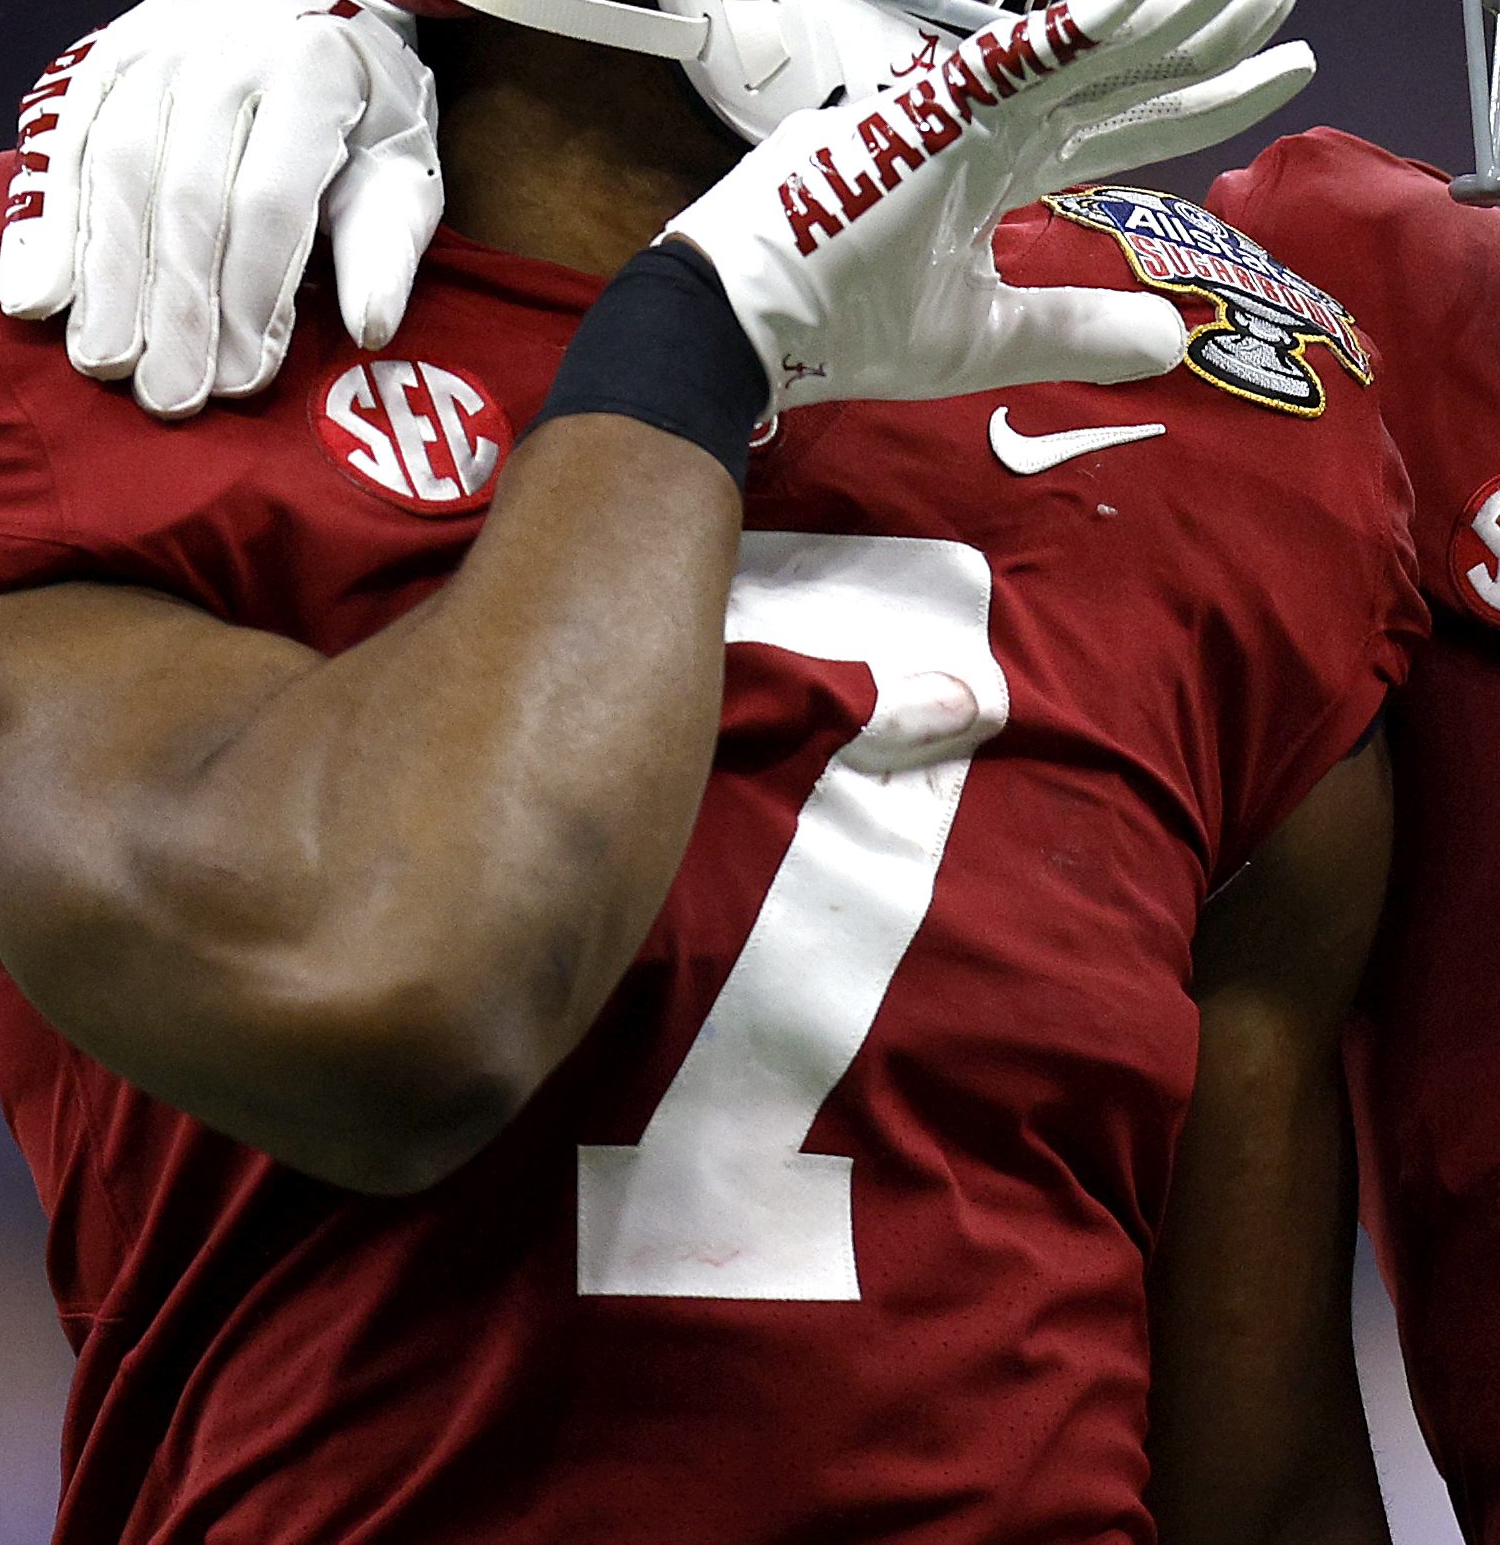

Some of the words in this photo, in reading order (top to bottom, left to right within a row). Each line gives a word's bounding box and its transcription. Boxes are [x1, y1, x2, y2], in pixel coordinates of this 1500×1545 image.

[777, 4, 1100, 258] ALABAMA
[1129, 231, 1258, 292] SUGAR
[325, 359, 500, 502] SEC
[577, 529, 1010, 1303] 7
